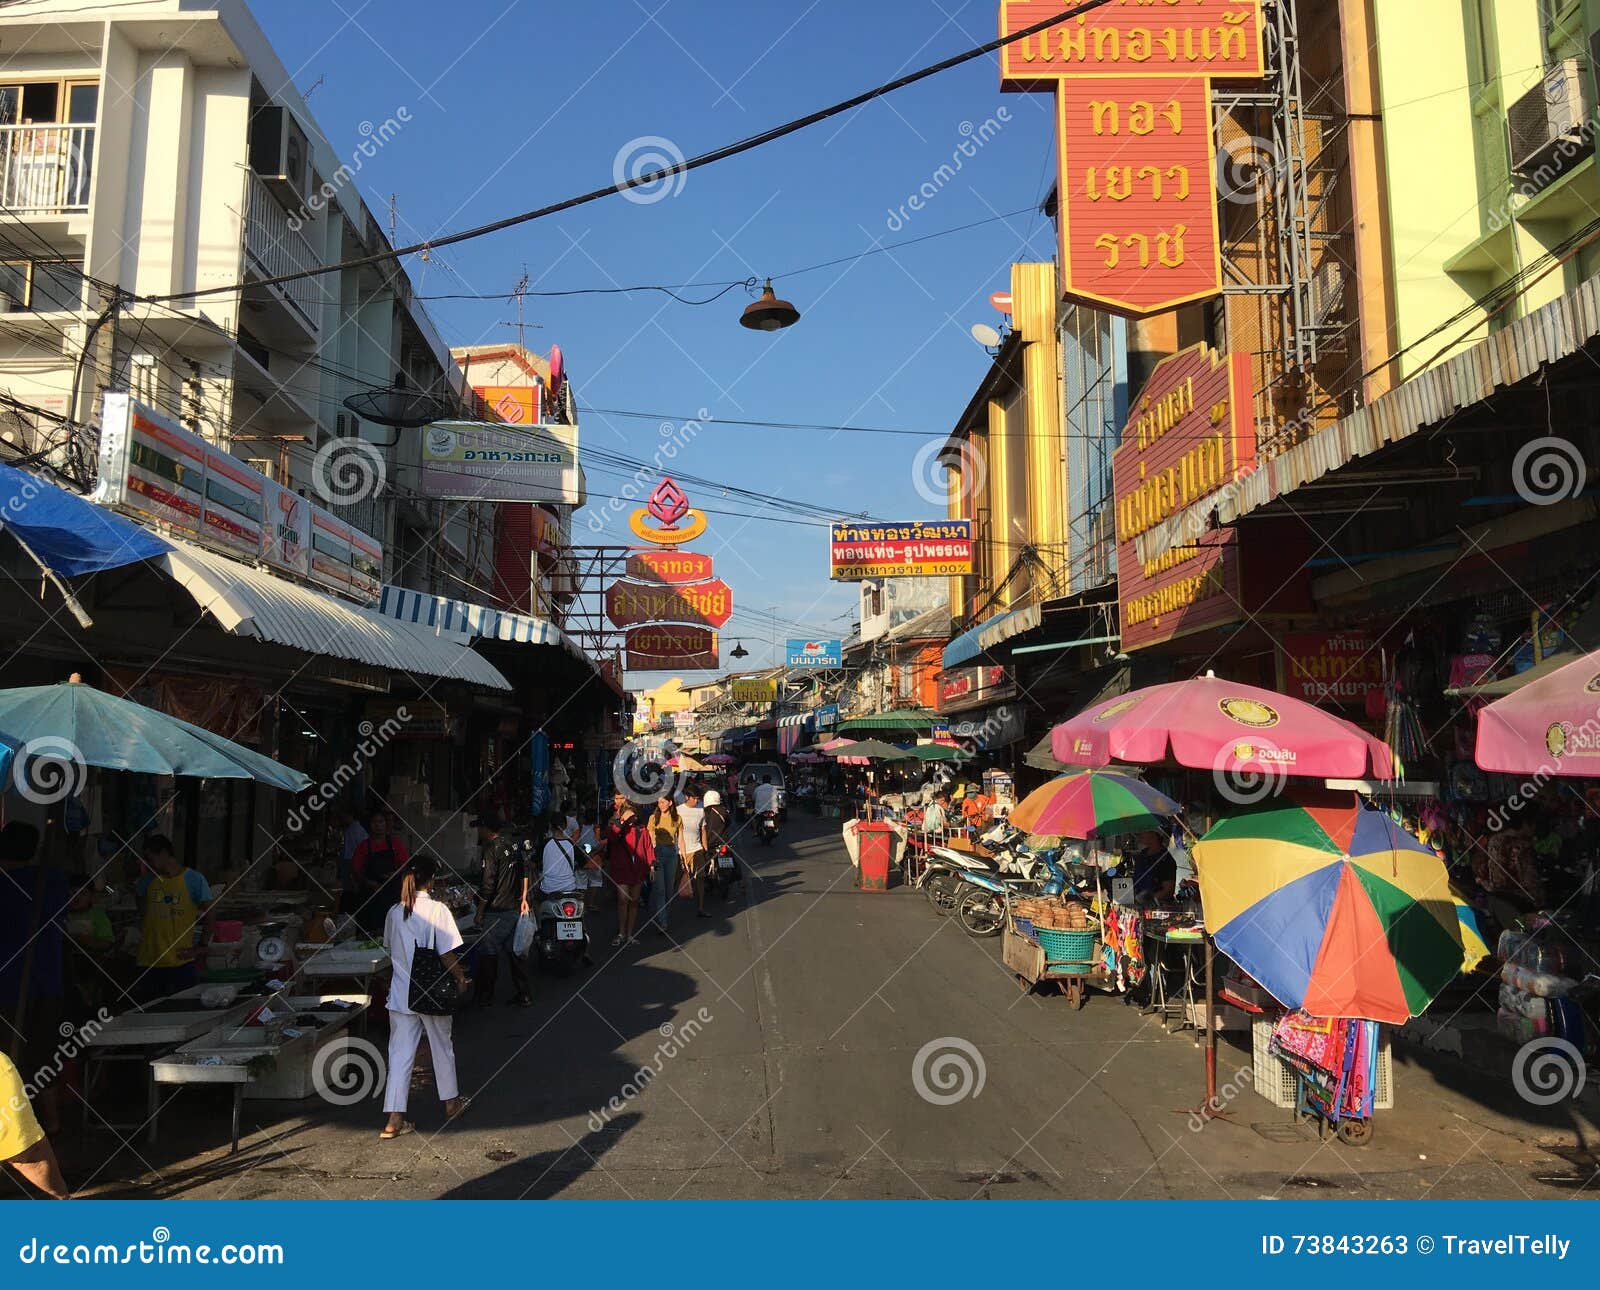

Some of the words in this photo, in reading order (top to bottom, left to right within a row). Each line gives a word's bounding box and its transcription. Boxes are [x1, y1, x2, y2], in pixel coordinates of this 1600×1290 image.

[1020, 11, 1251, 61] แม่ทองแท้
[1088, 100, 1182, 135] ทอง
[1085, 165, 1190, 201] เยาว
[1094, 224, 1188, 269] ราช
[464, 450, 562, 463] อาหารทะเล
[833, 522, 968, 541] ห้างทองวัฒนา
[833, 543, 969, 563] ทองแท่ง-รูปพรรณ
[636, 554, 704, 575] ห้างทอง
[835, 565, 923, 577] จากเยาวราช
[932, 564, 967, 574] 100%
